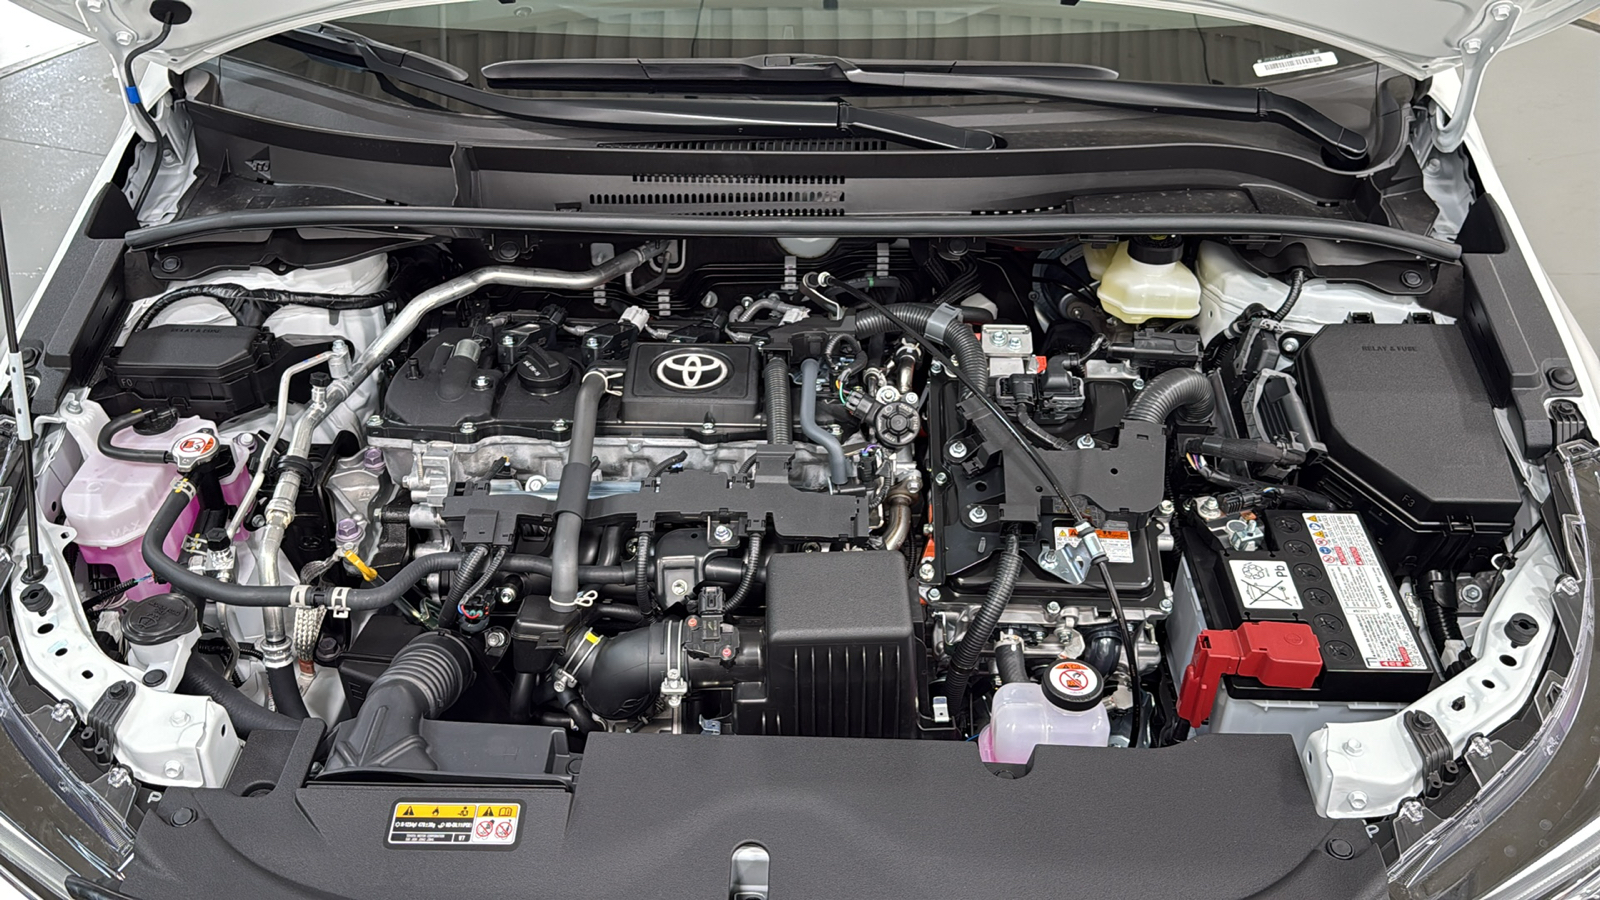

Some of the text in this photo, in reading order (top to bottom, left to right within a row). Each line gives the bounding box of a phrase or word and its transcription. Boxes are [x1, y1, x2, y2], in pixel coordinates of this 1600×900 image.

[1402, 494, 1416, 507] F3
[110, 520, 142, 538] MAX
[1274, 565, 1288, 577] Pb
[1376, 585, 1389, 601] YUASA
